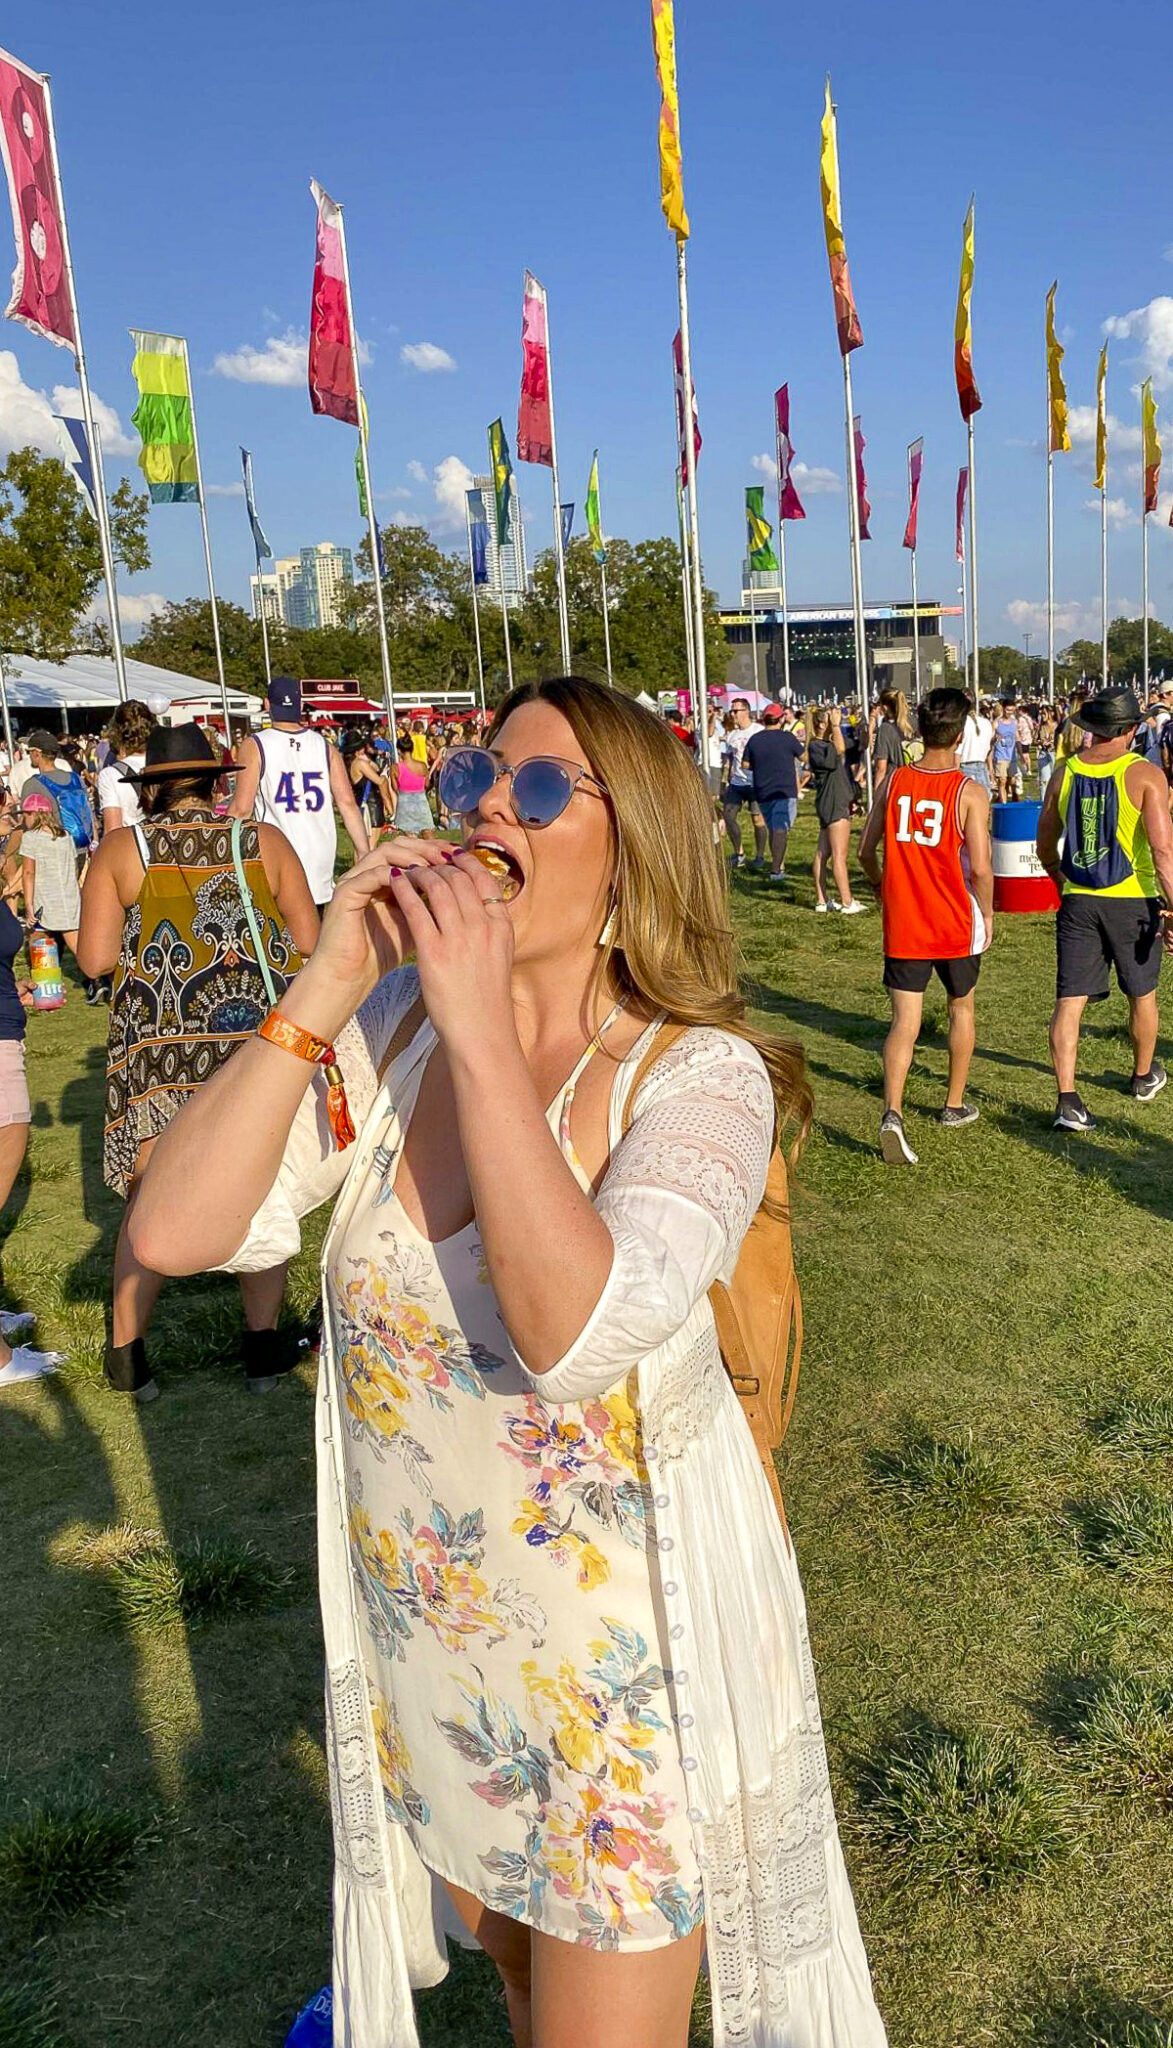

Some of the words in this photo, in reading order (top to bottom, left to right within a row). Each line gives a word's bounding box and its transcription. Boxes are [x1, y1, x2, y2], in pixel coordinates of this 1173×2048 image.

[789, 609, 836, 620] AMERICAN
[838, 609, 879, 619] EXPESS
[317, 684, 331, 692] CLUB
[275, 771, 324, 813] 45
[895, 795, 944, 848] 13
